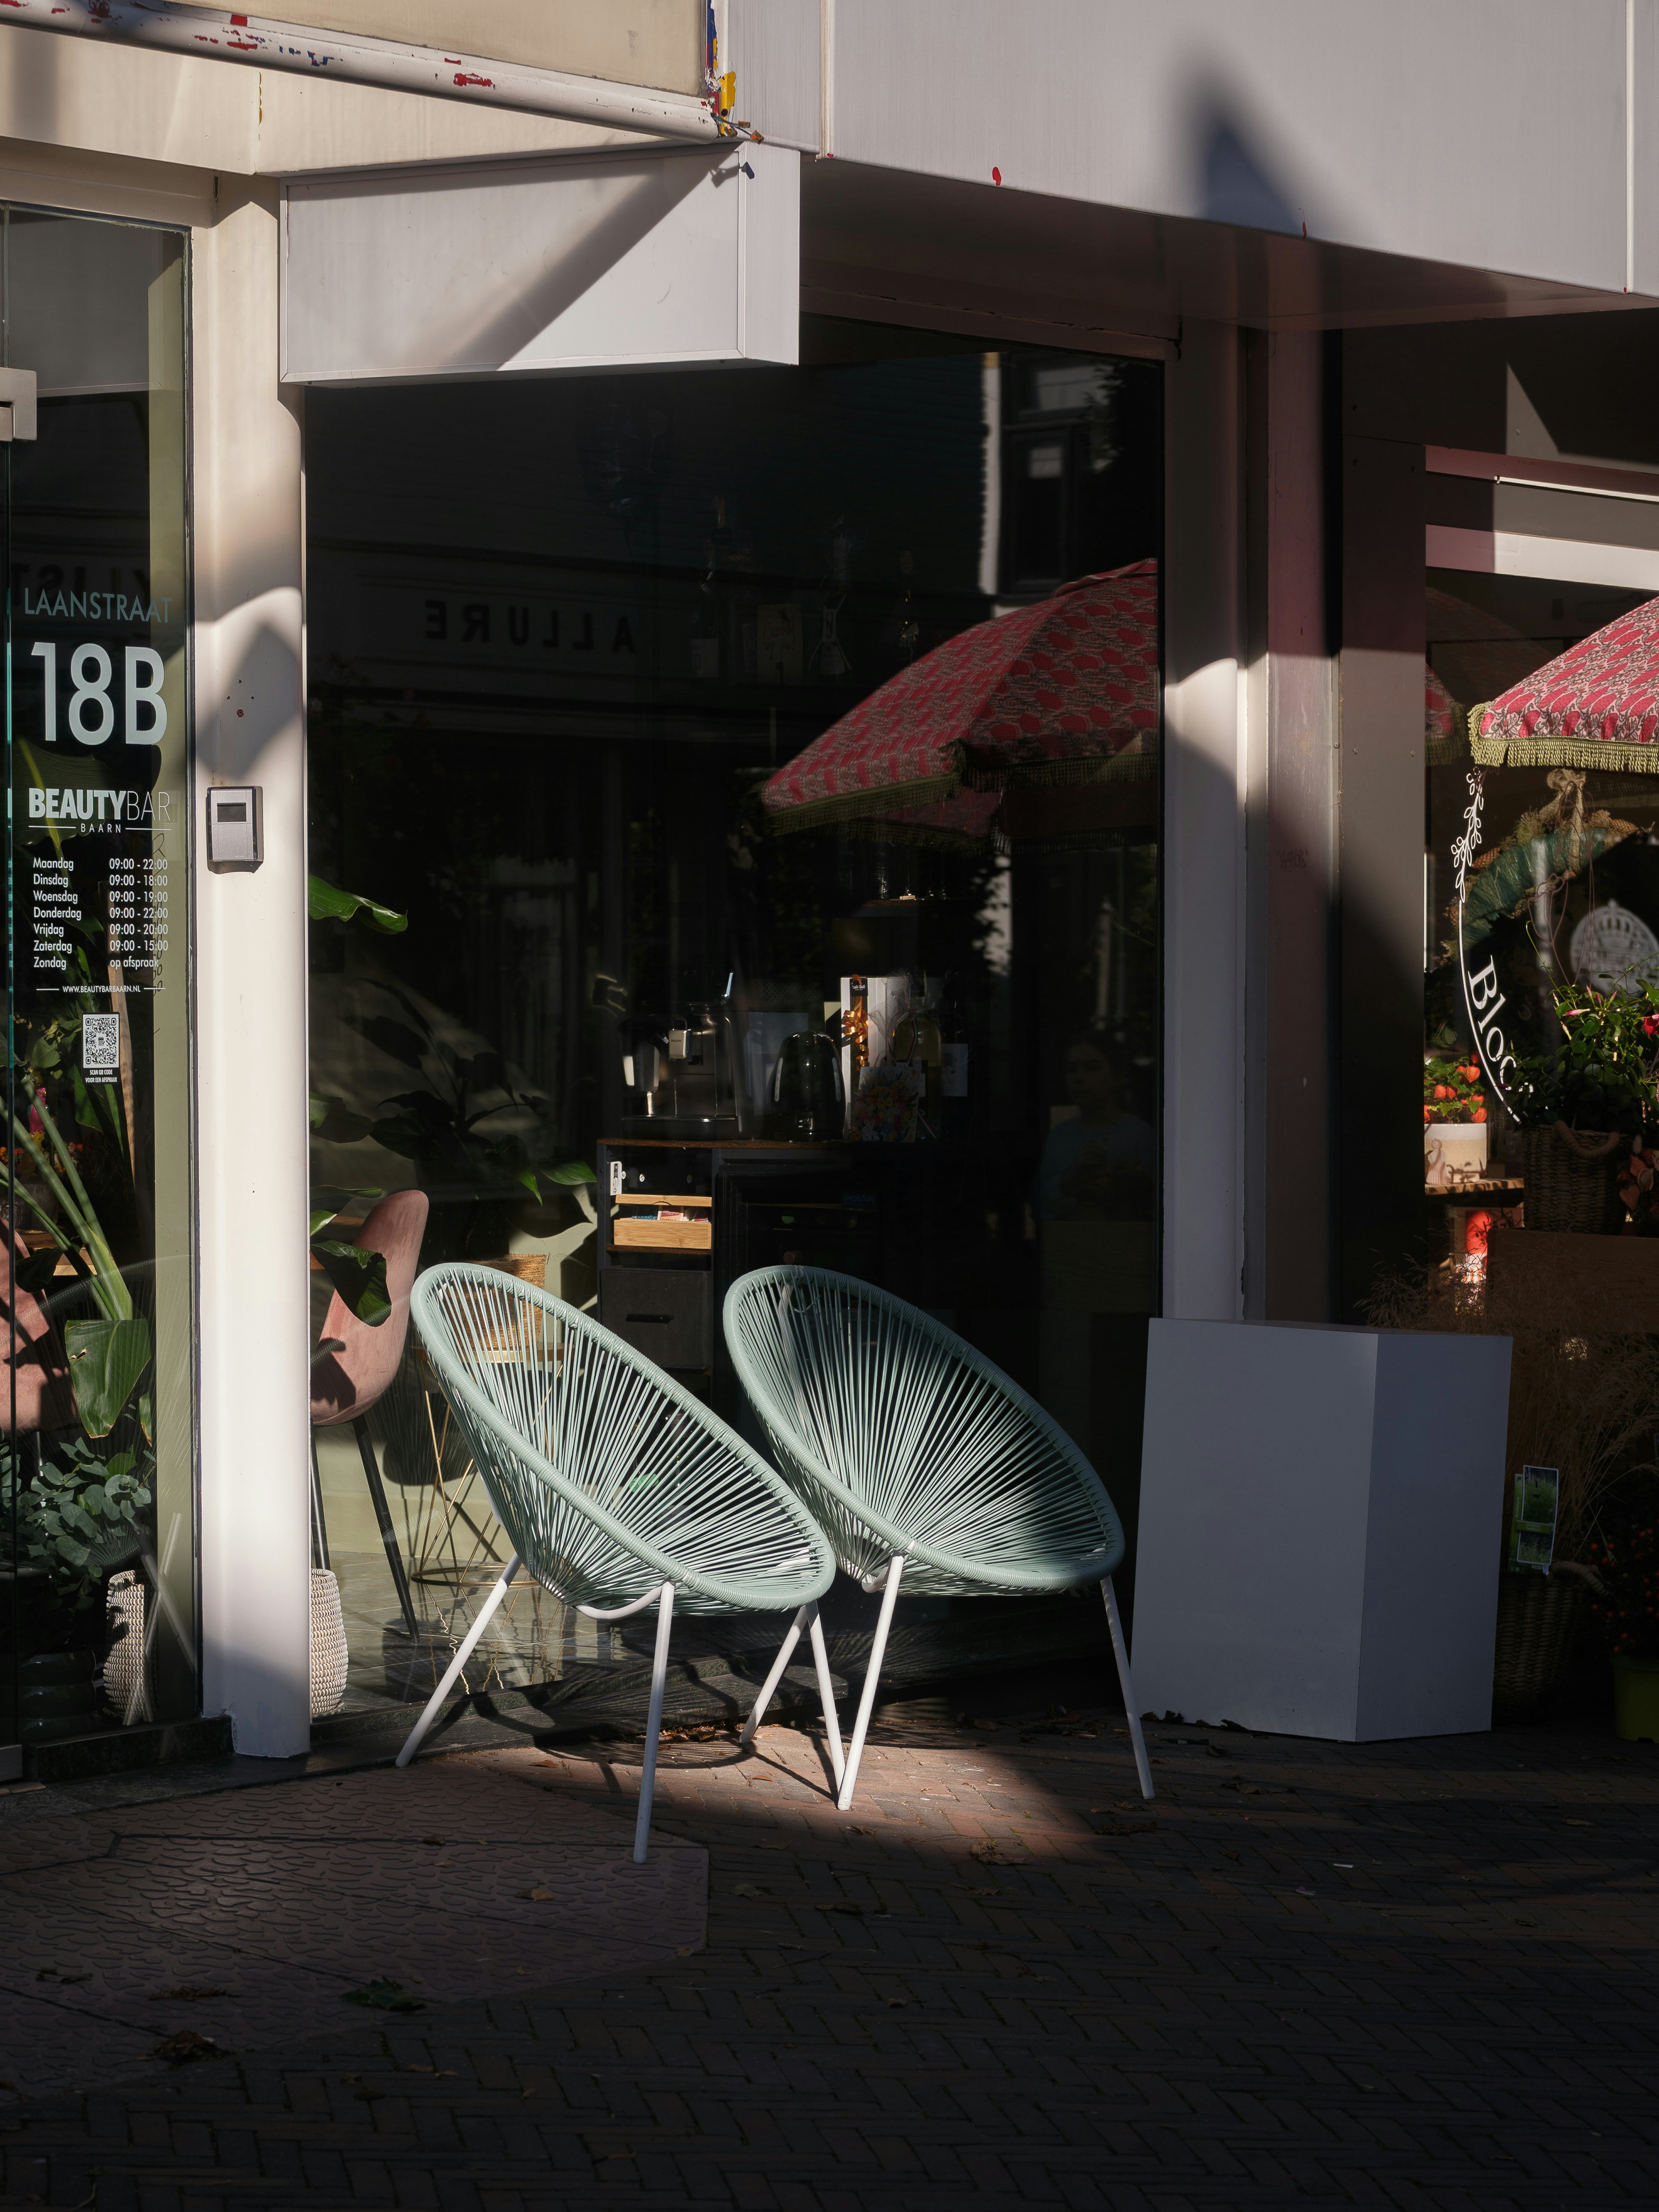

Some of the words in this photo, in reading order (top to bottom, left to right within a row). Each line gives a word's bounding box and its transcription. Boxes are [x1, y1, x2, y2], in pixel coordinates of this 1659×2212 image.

[25, 588, 172, 623] LAANSTRAAT
[31, 642, 168, 745] 18B
[29, 787, 171, 822] BEAUTYBAR
[81, 823, 121, 833] BAARN
[33, 857, 74, 871] Maandag
[110, 858, 134, 869] 09:00
[143, 859, 168, 870] 22:00
[34, 873, 68, 888] Dinsdag
[110, 875, 134, 886] 09:00
[144, 875, 168, 886] 18:00
[33, 890, 78, 904] Woensdag
[110, 891, 134, 902] 09:00
[144, 891, 168, 902] 19:00
[34, 906, 81, 921] Donderdag
[110, 907, 134, 919] 09:00
[144, 907, 168, 919] 22:00
[33, 923, 64, 937] Vrijdag
[110, 924, 134, 935] 09:00
[144, 924, 168, 935] 20:00
[34, 939, 72, 954] Zaterdag
[110, 940, 135, 951] 09:00
[144, 940, 168, 951] 15:00
[34, 956, 66, 970] Zondag
[110, 959, 121, 970] op
[123, 956, 159, 970] afspraak
[62, 985, 141, 993] WWW.BEAUTYBARBAARN.NL
[844, 1194, 875, 1202] POLAR
